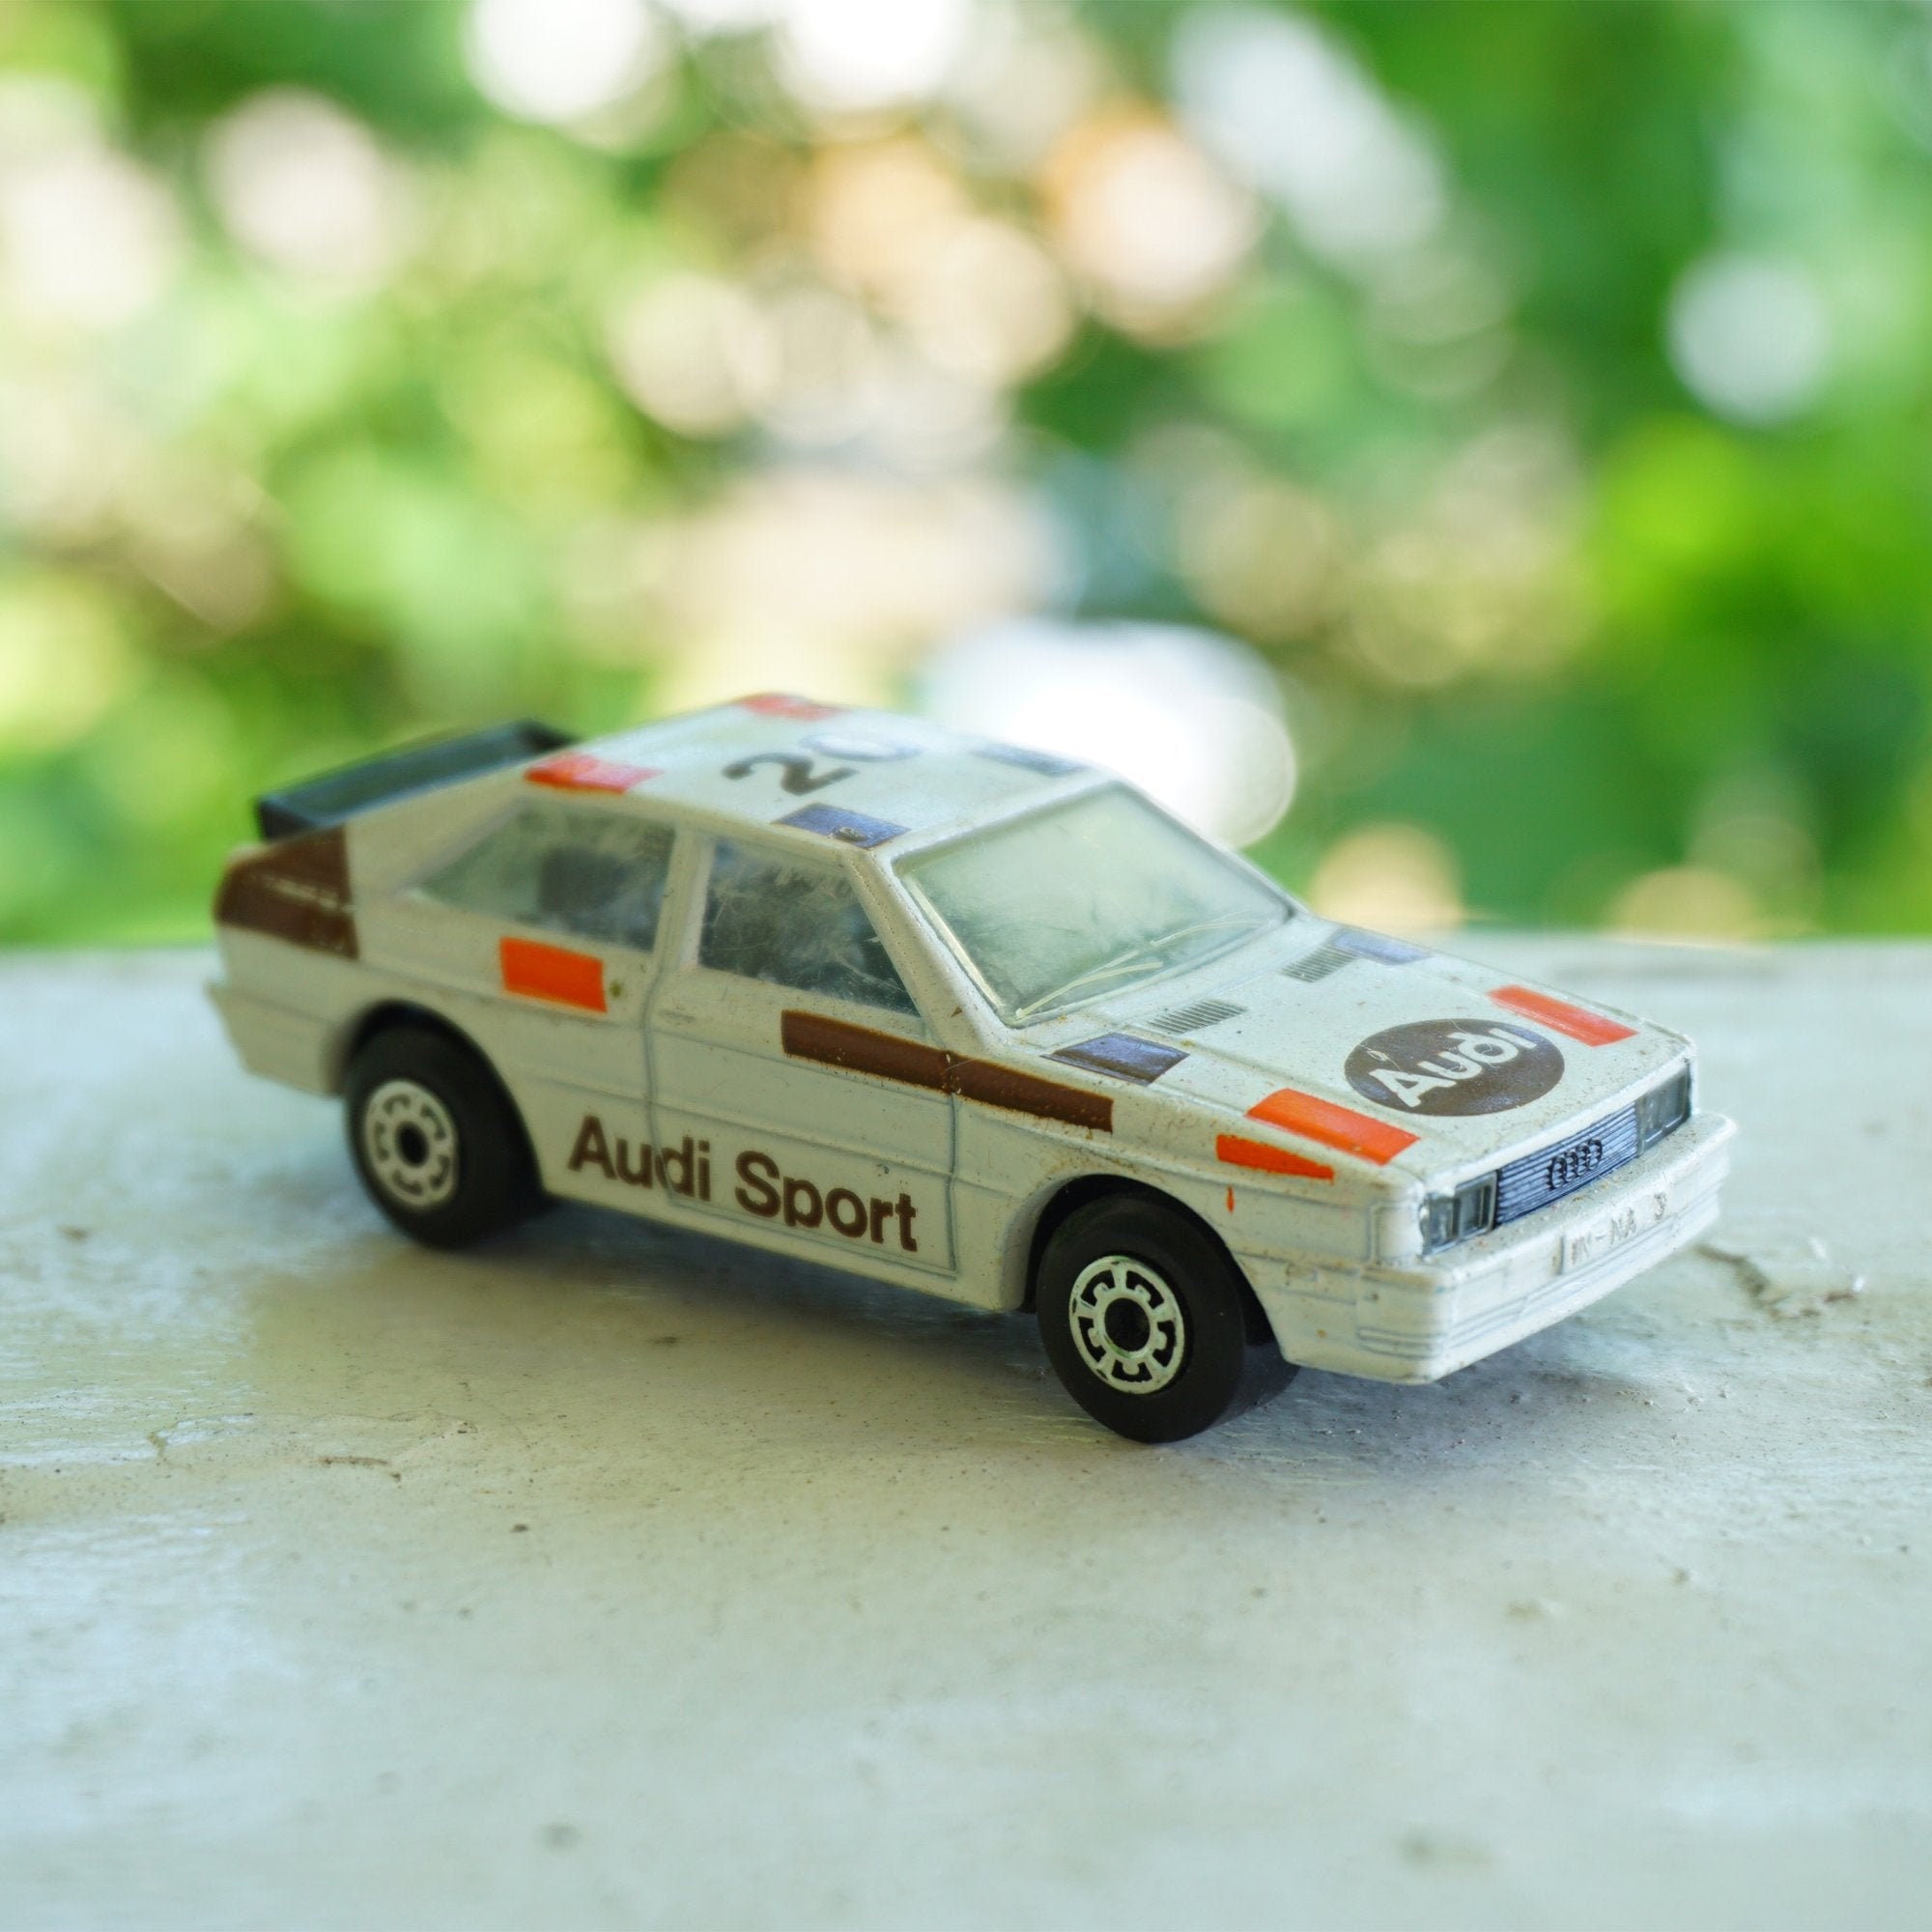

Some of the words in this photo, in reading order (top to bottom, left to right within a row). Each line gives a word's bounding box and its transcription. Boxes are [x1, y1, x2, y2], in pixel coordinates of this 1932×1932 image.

[722, 731, 923, 796] 20
[568, 1115, 712, 1203] Audi
[734, 1150, 919, 1253] Sport
